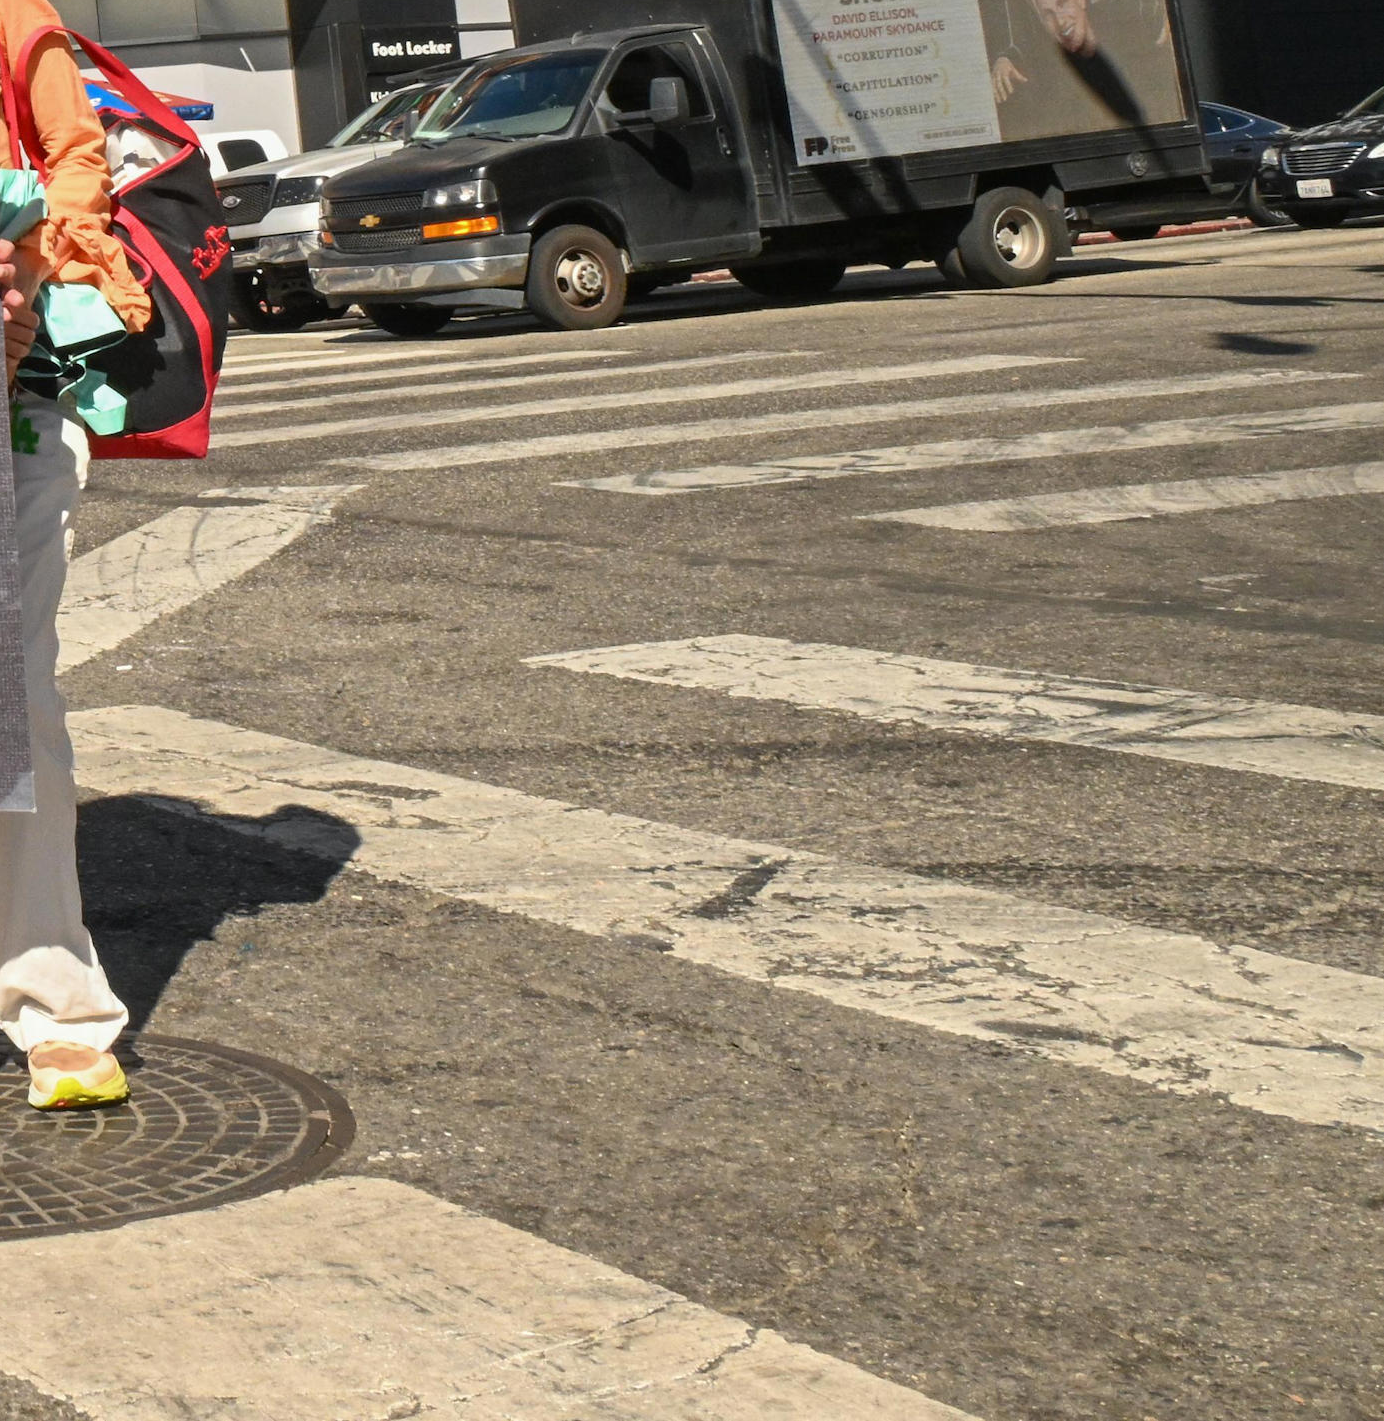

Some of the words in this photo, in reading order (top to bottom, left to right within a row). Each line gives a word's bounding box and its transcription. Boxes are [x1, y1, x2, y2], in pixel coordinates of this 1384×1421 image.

[832, 12, 866, 25] DAVID
[870, 7, 919, 21] ELLISON,
[813, 26, 882, 43] PARAMOUNT
[886, 20, 945, 36] SKYDANCE
[372, 42, 404, 57] Foot
[406, 40, 453, 55] Locker
